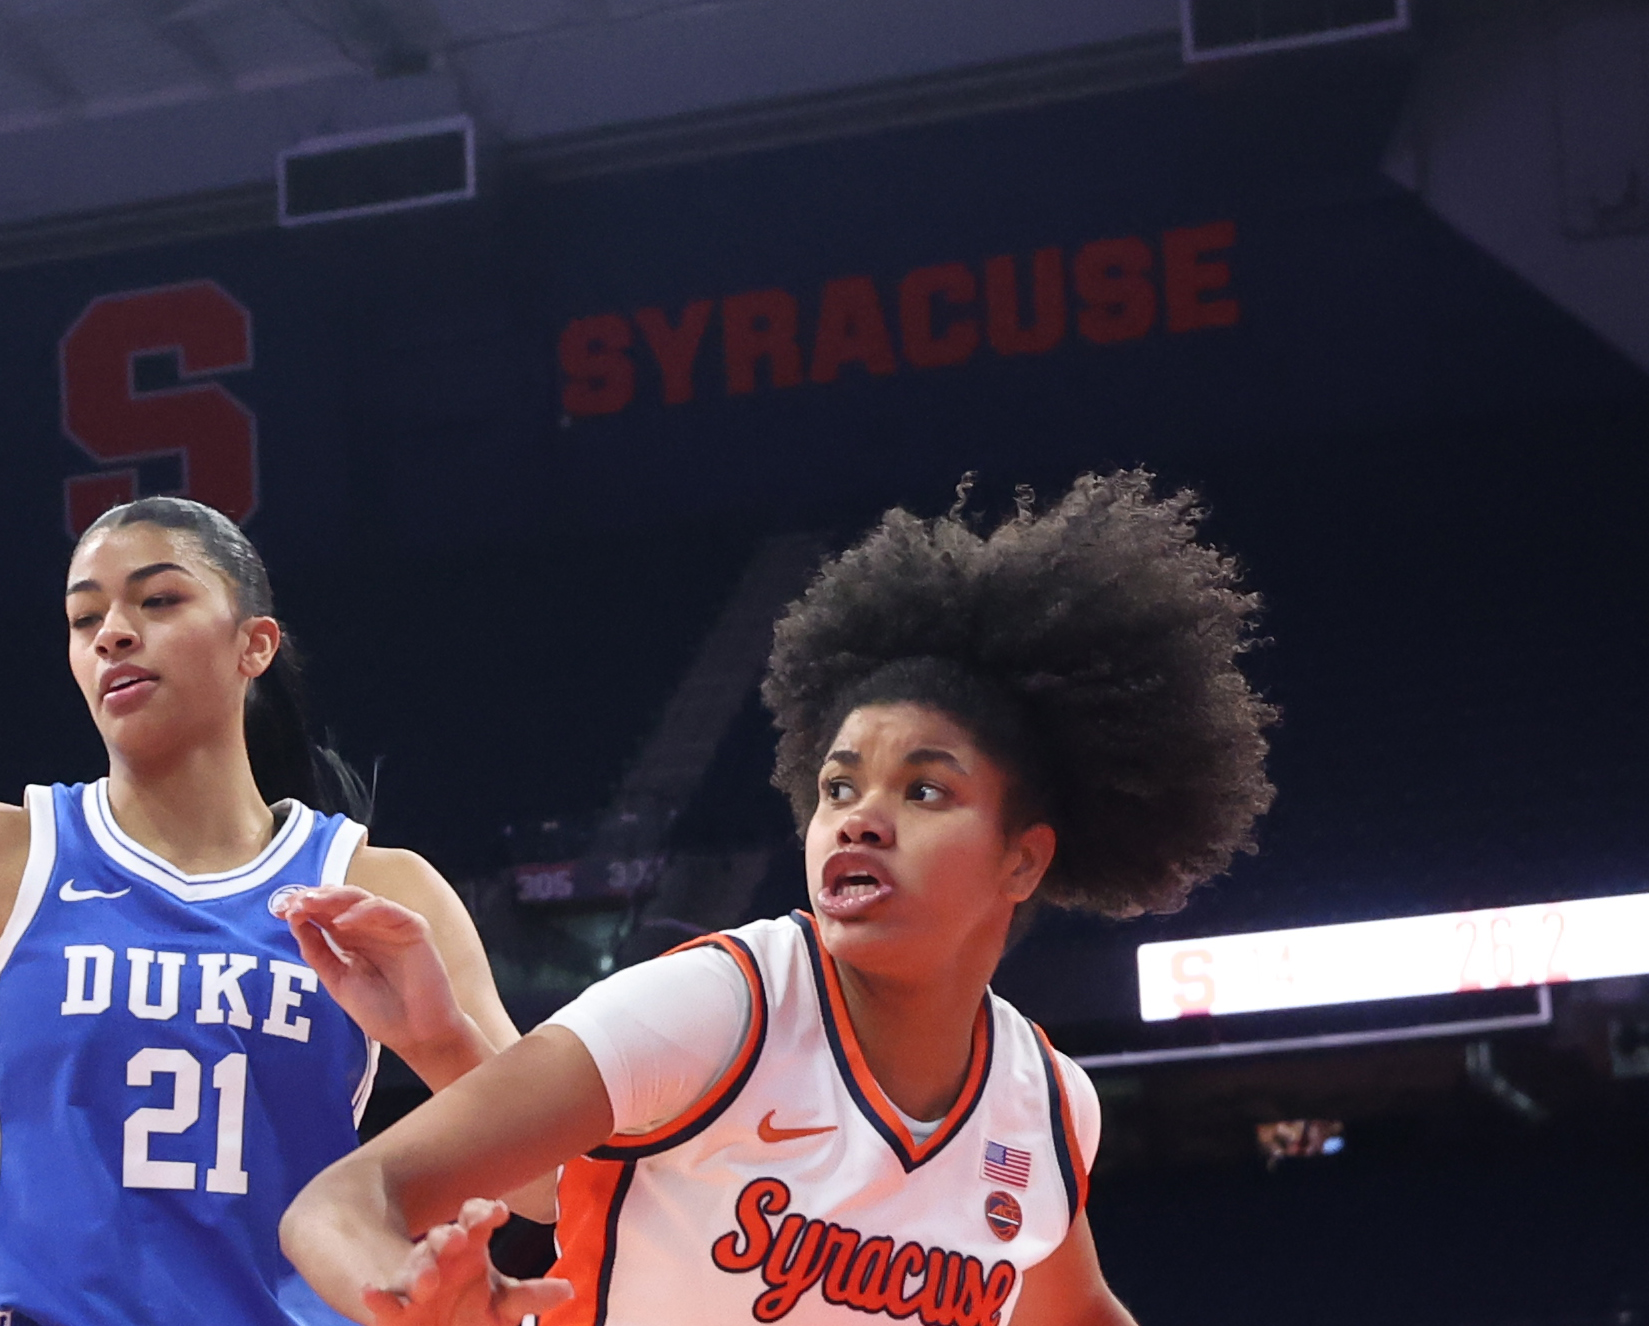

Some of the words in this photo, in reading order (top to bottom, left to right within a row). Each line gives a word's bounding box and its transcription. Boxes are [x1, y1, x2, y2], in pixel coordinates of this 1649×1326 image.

[558, 220, 1240, 417] SYRACUSE
[59, 278, 259, 540] S
[61, 944, 319, 1043] DUKE
[122, 1047, 248, 1195] 21
